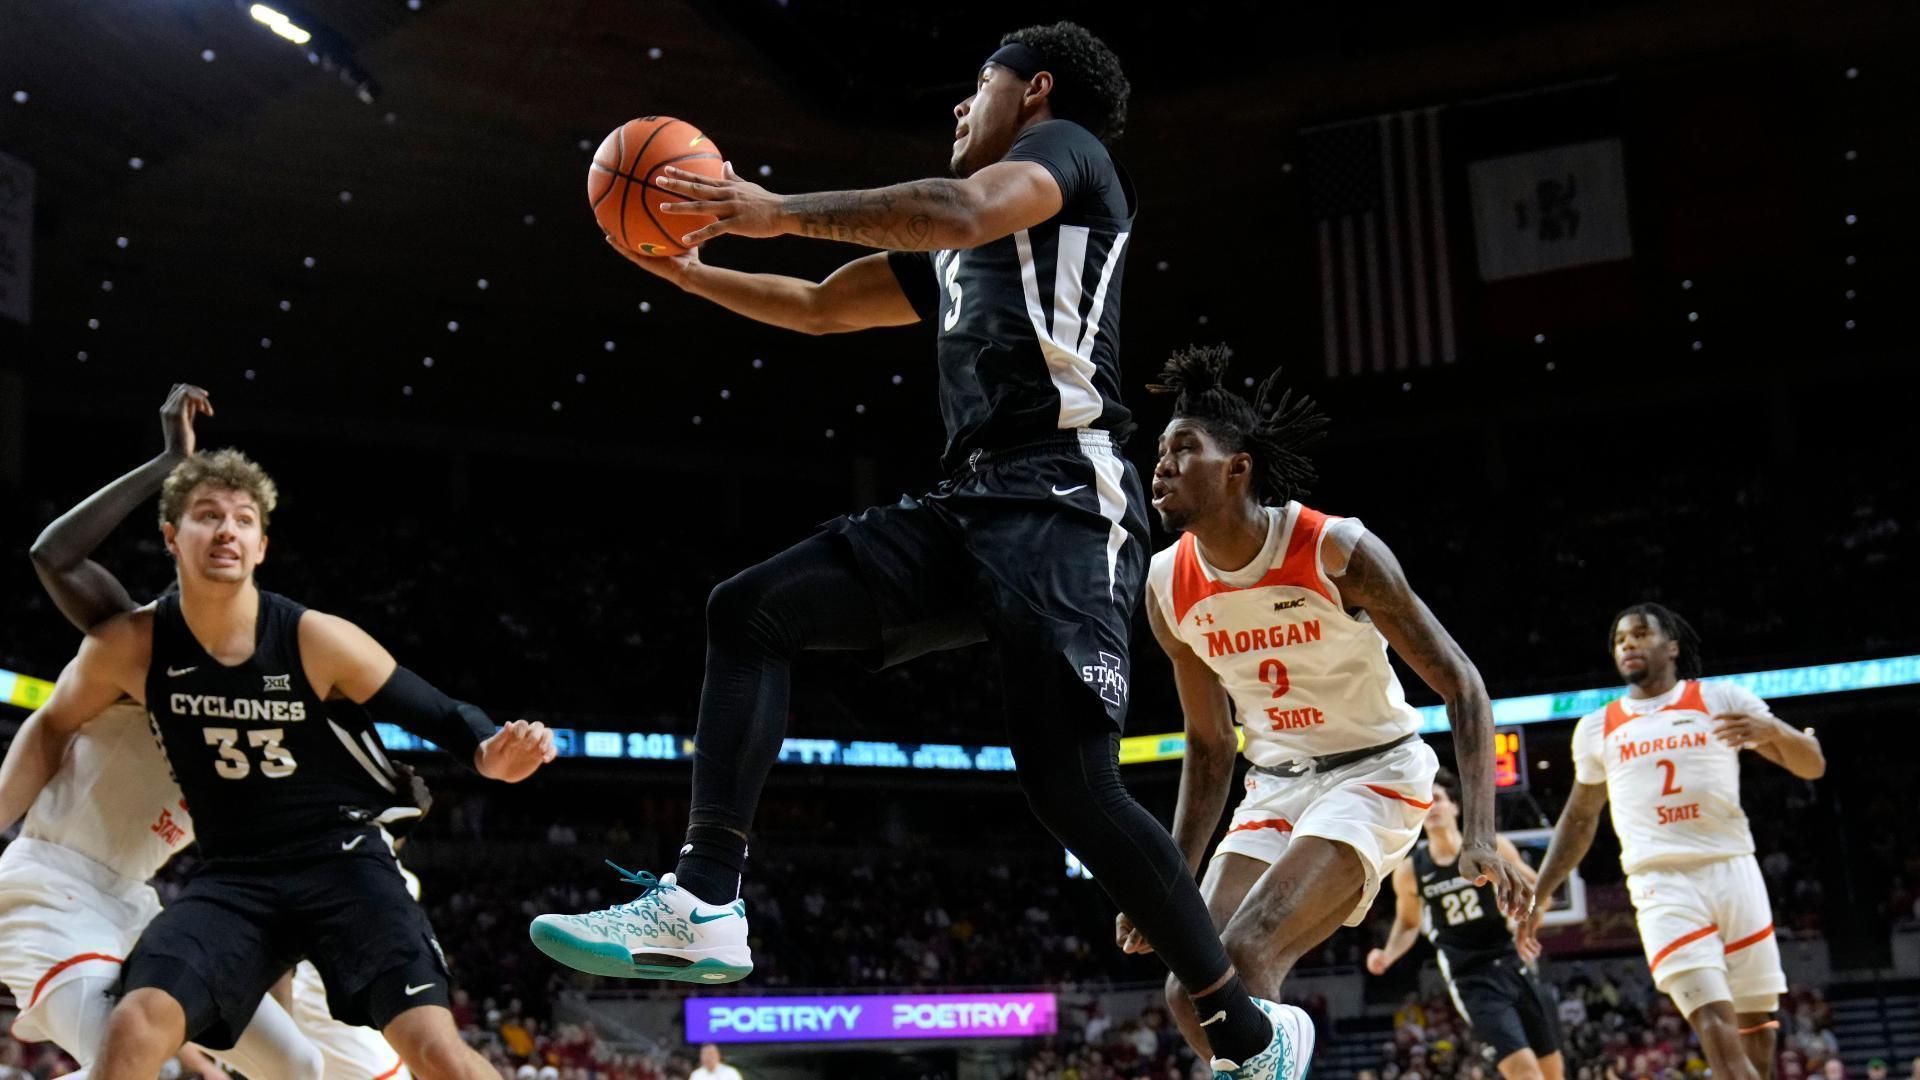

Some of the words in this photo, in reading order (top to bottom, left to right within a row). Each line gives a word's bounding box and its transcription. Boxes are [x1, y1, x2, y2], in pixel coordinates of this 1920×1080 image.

[1274, 598, 1306, 612] MEAC
[1201, 620, 1322, 658] MORGAN
[1258, 658, 1291, 699] 9
[170, 693, 307, 721] CYCLONES
[1263, 706, 1325, 731] STATE
[202, 727, 298, 780] 33
[628, 733, 675, 759] 3:01
[1618, 732, 1707, 762] MORGAN
[1655, 758, 1683, 797] 2
[1656, 803, 1700, 825] STATE
[1441, 888, 1484, 926] 22
[708, 1004, 863, 1034] POETRYY
[892, 1002, 1035, 1030] POETRYY
